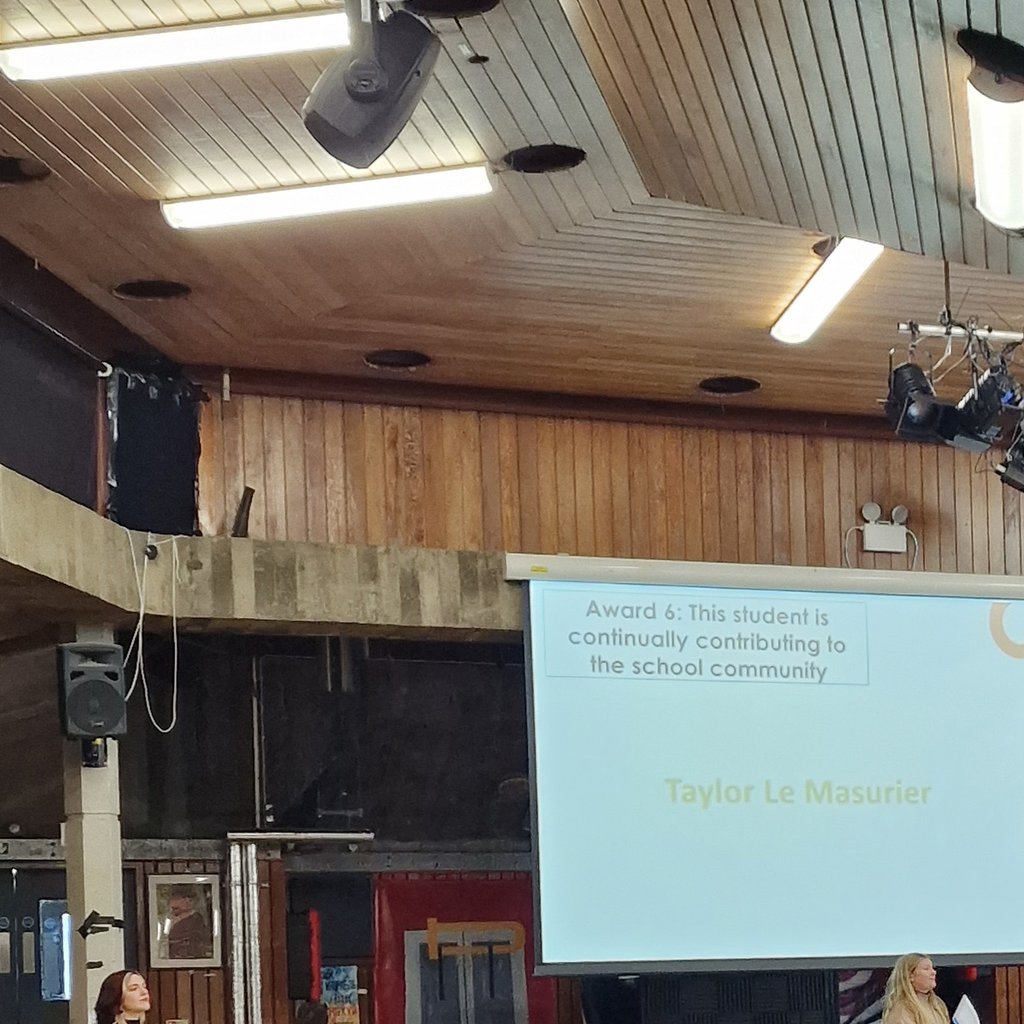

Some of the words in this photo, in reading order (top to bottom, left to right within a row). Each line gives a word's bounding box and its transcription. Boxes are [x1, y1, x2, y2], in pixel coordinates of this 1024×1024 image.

[585, 599, 657, 620] Award
[664, 603, 682, 620] 6:
[688, 603, 726, 623] This
[733, 606, 809, 626] student
[815, 608, 829, 626] is
[568, 627, 688, 652] continually
[696, 632, 820, 657] contributing
[827, 636, 846, 653] to
[590, 655, 625, 674] the
[632, 657, 703, 676] school
[710, 660, 828, 684] community
[664, 778, 754, 811] Taylor
[764, 779, 795, 804] Le
[805, 778, 932, 804] Masurier
